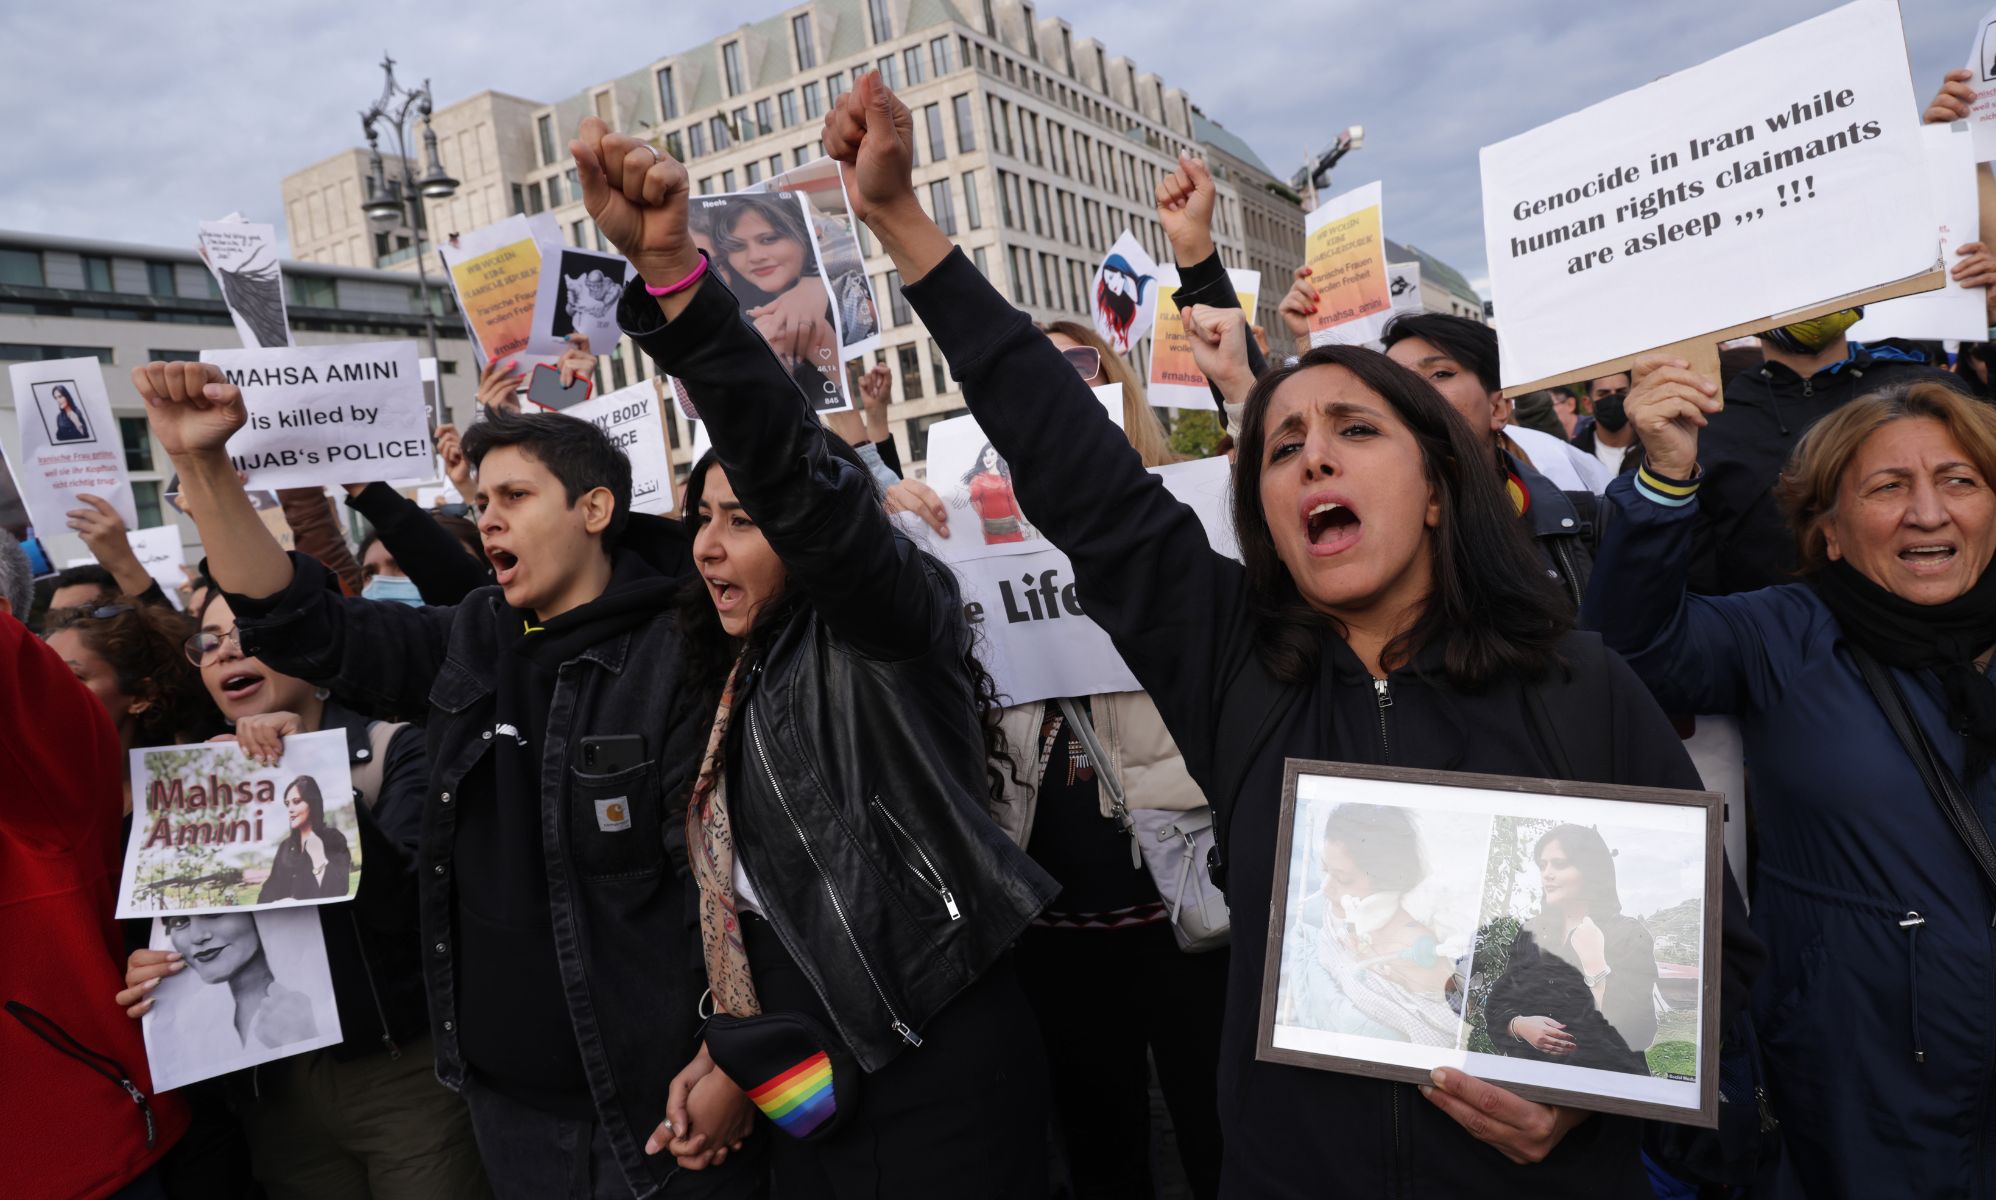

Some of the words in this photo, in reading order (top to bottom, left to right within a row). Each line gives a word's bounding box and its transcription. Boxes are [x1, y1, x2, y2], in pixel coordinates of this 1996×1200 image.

[1513, 166, 1640, 221] Genocide
[1650, 152, 1678, 175] in
[1690, 124, 1755, 161] Iran
[1765, 89, 1855, 132] while
[1510, 212, 1605, 257] human
[1616, 179, 1705, 224] rights
[1715, 119, 1882, 189] claimants
[702, 199, 727, 208] Reels
[1567, 246, 1614, 274] are
[1624, 211, 1721, 257] asleep
[1777, 175, 1815, 207] !!!
[1311, 265, 1344, 284] Iranische
[1345, 257, 1373, 271] Frauen
[1342, 270, 1371, 286] Freiheit
[226, 366, 318, 388] MAHSA
[326, 361, 399, 383] AMINI
[251, 412, 271, 430] is
[279, 406, 343, 428] killed
[351, 405, 378, 425] by
[612, 399, 648, 424] BODY
[73, 452, 89, 461] Frau
[327, 439, 427, 463] POLICE!
[999, 569, 1086, 624] Life
[151, 774, 275, 811] Mahsa
[144, 809, 263, 848] Amini
